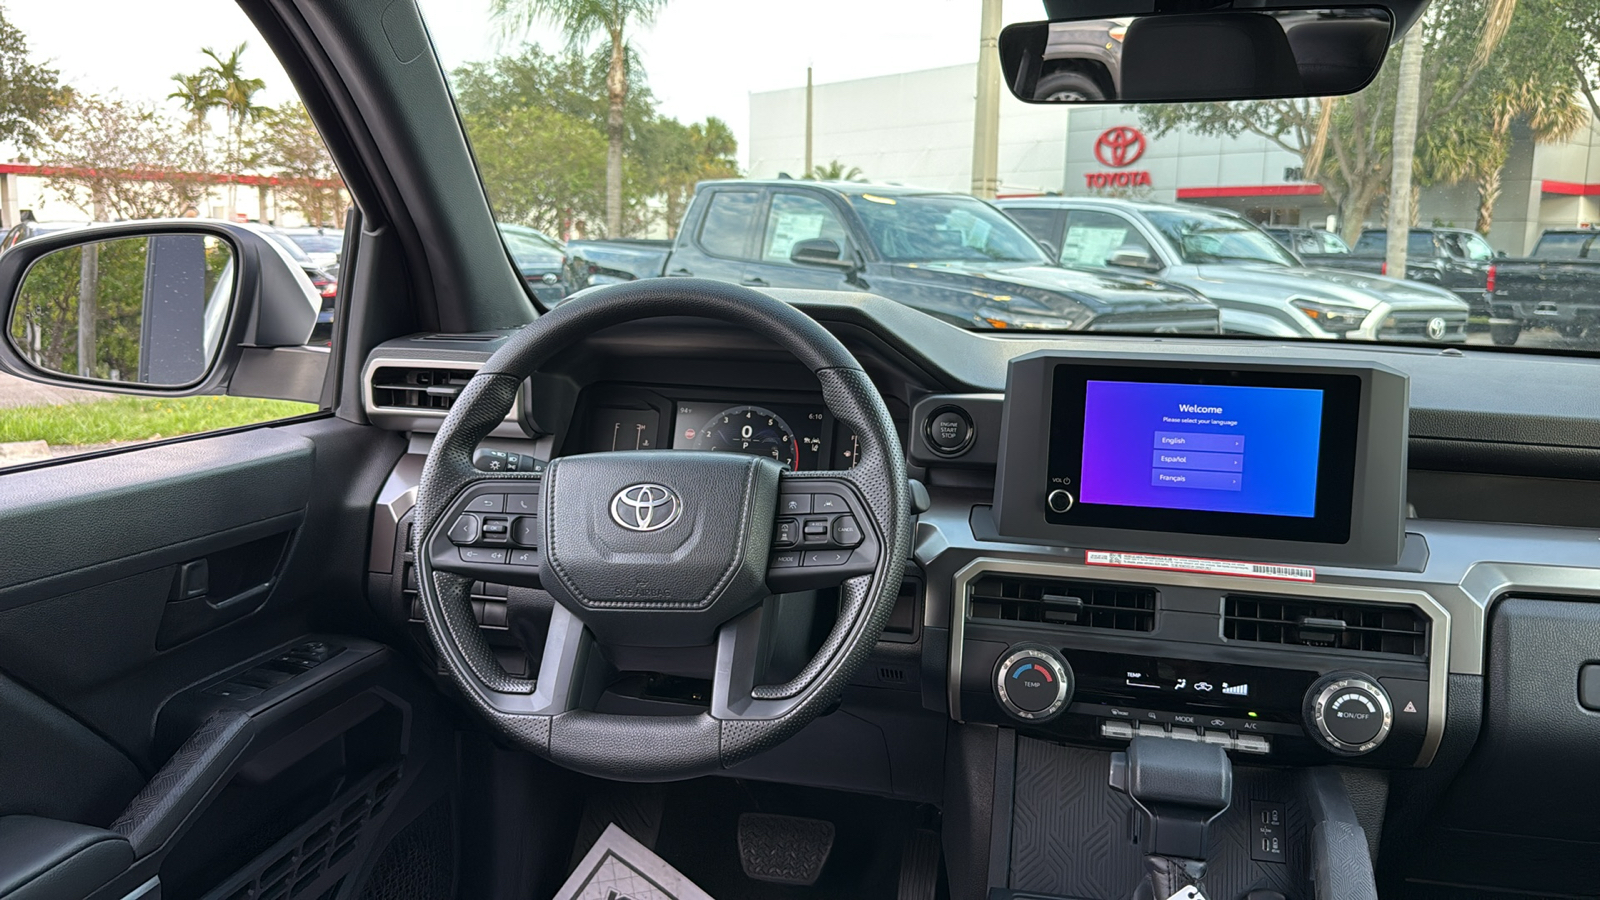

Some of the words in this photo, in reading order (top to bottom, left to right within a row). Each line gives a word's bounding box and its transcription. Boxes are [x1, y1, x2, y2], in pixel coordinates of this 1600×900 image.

[1085, 171, 1151, 188] TOYOTA
[1178, 403, 1223, 414] Welcome
[723, 416, 729, 424] 3
[768, 418, 773, 426] 5
[1211, 419, 1238, 427] language
[706, 430, 712, 438] 2
[741, 425, 753, 438] 0
[1161, 436, 1186, 445] English
[1160, 455, 1187, 463] Español
[1159, 474, 1186, 482] Français
[615, 588, 633, 598] SRS
[634, 588, 671, 598] AIRBAG
[1175, 715, 1194, 723] MODE
[1343, 711, 1369, 720] ON/OFF
